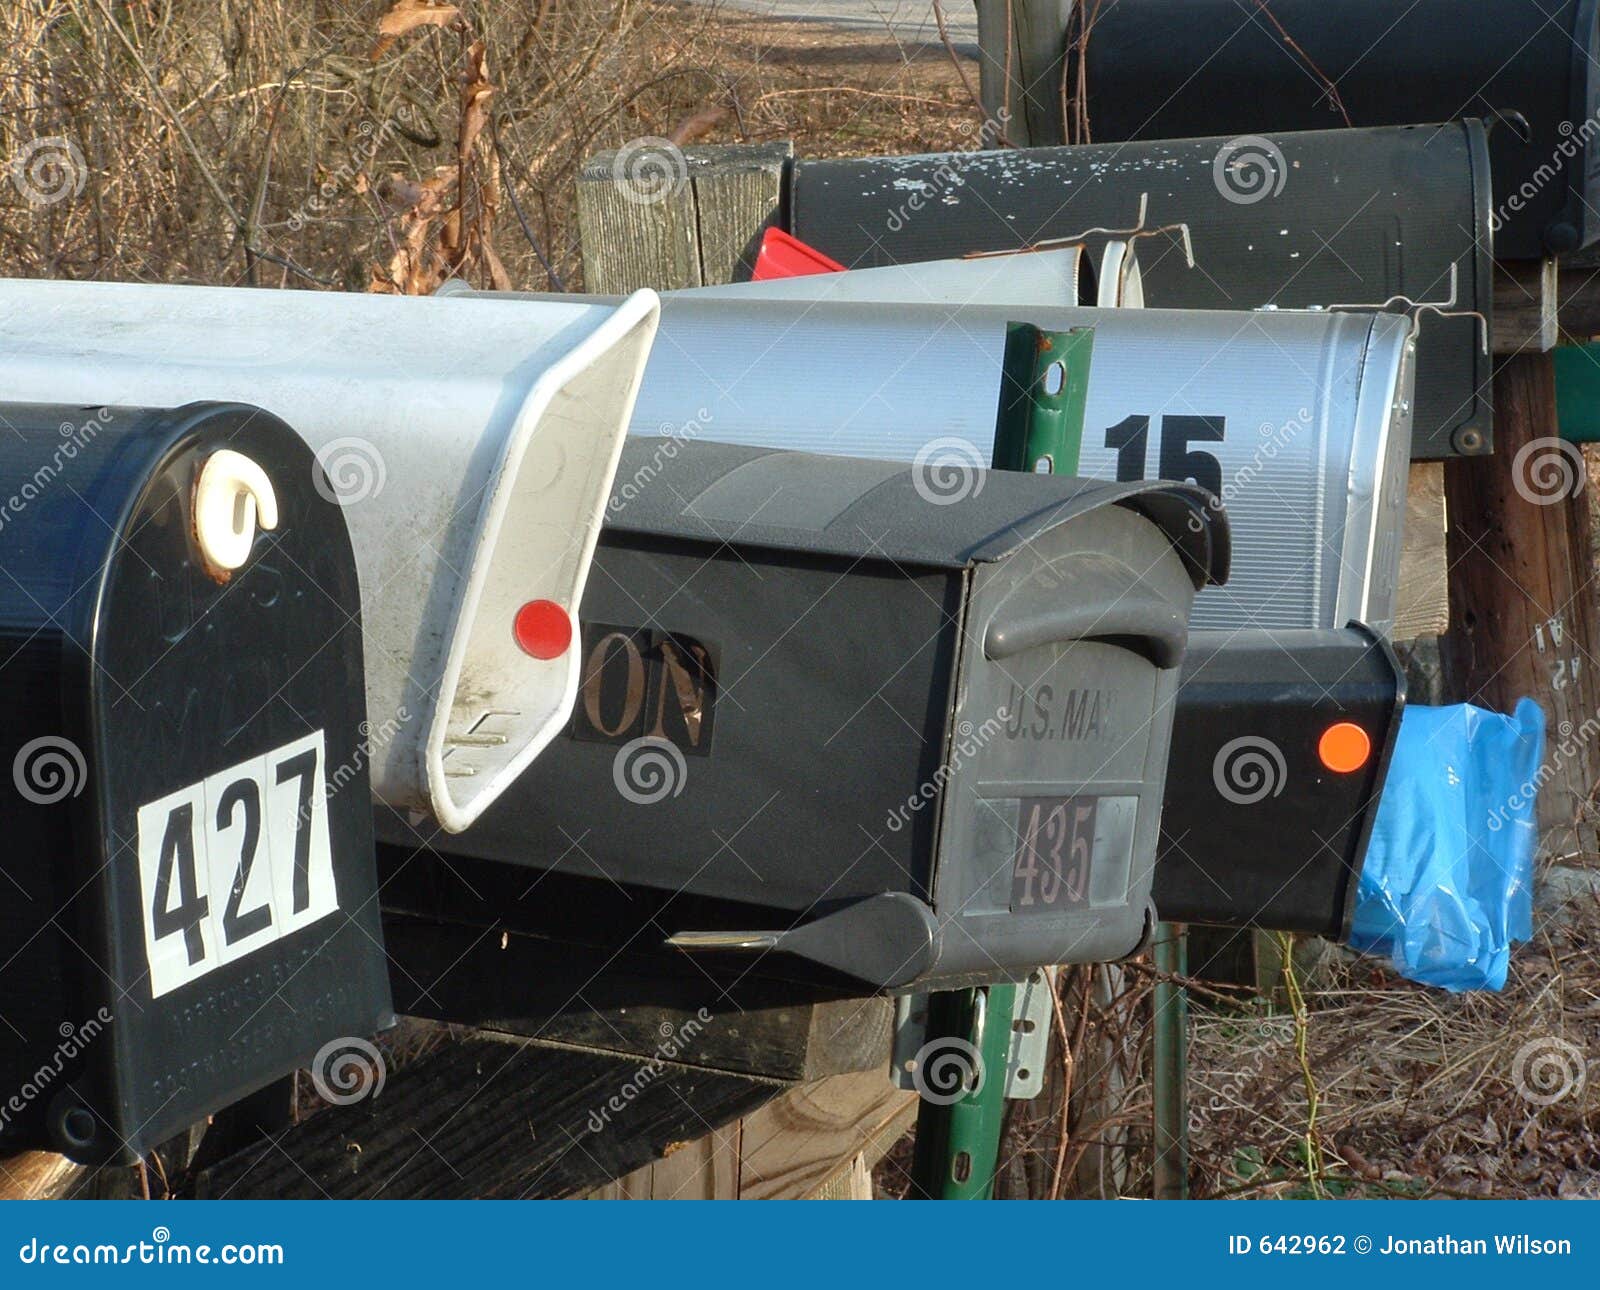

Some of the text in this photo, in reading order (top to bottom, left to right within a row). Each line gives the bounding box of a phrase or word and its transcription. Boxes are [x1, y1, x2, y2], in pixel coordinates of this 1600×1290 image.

[1104, 415, 1226, 501] 15
[1006, 683, 1055, 741] U.S.
[153, 747, 317, 966] 427
[1015, 803, 1093, 905] 435
